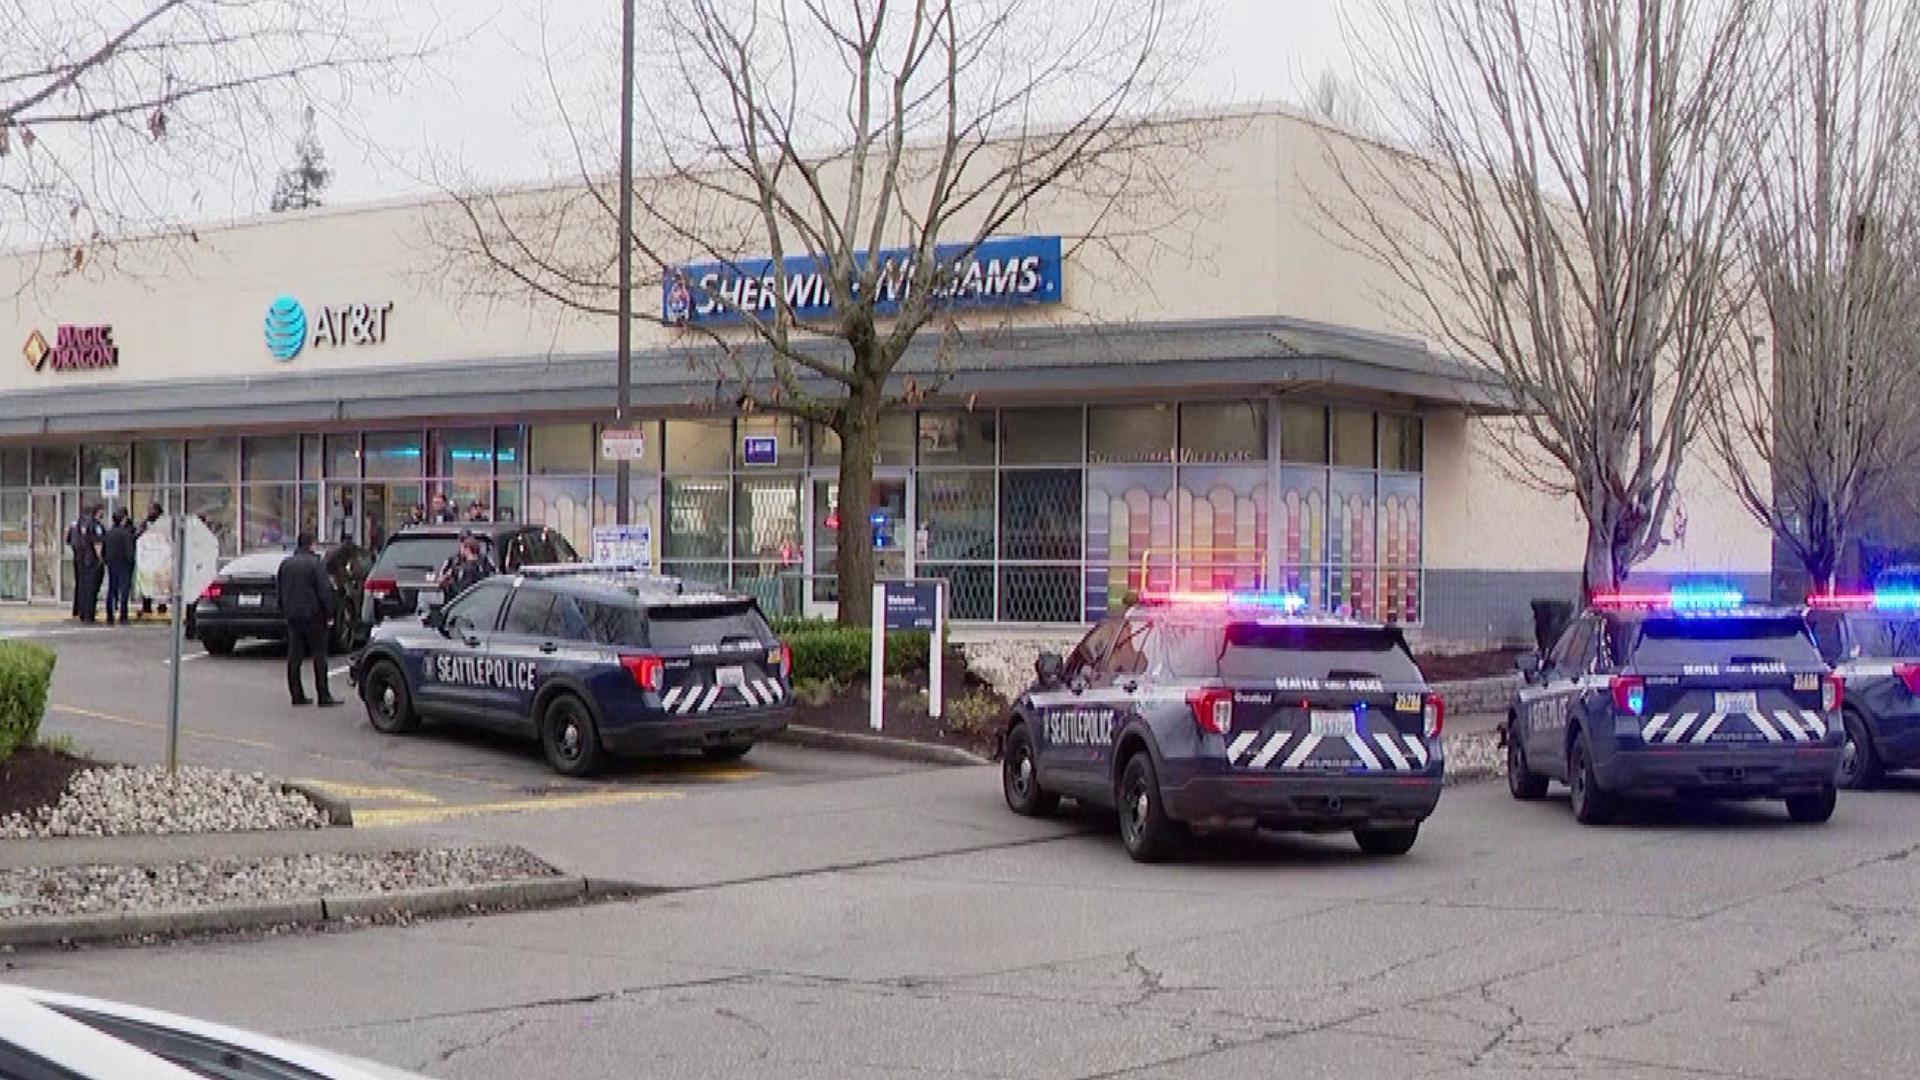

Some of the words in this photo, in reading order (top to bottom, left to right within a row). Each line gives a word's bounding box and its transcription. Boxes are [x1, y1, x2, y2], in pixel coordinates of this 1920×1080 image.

[313, 301, 393, 347] AT&T
[57, 326, 113, 348] MAGIC
[50, 346, 118, 371] DRAGON
